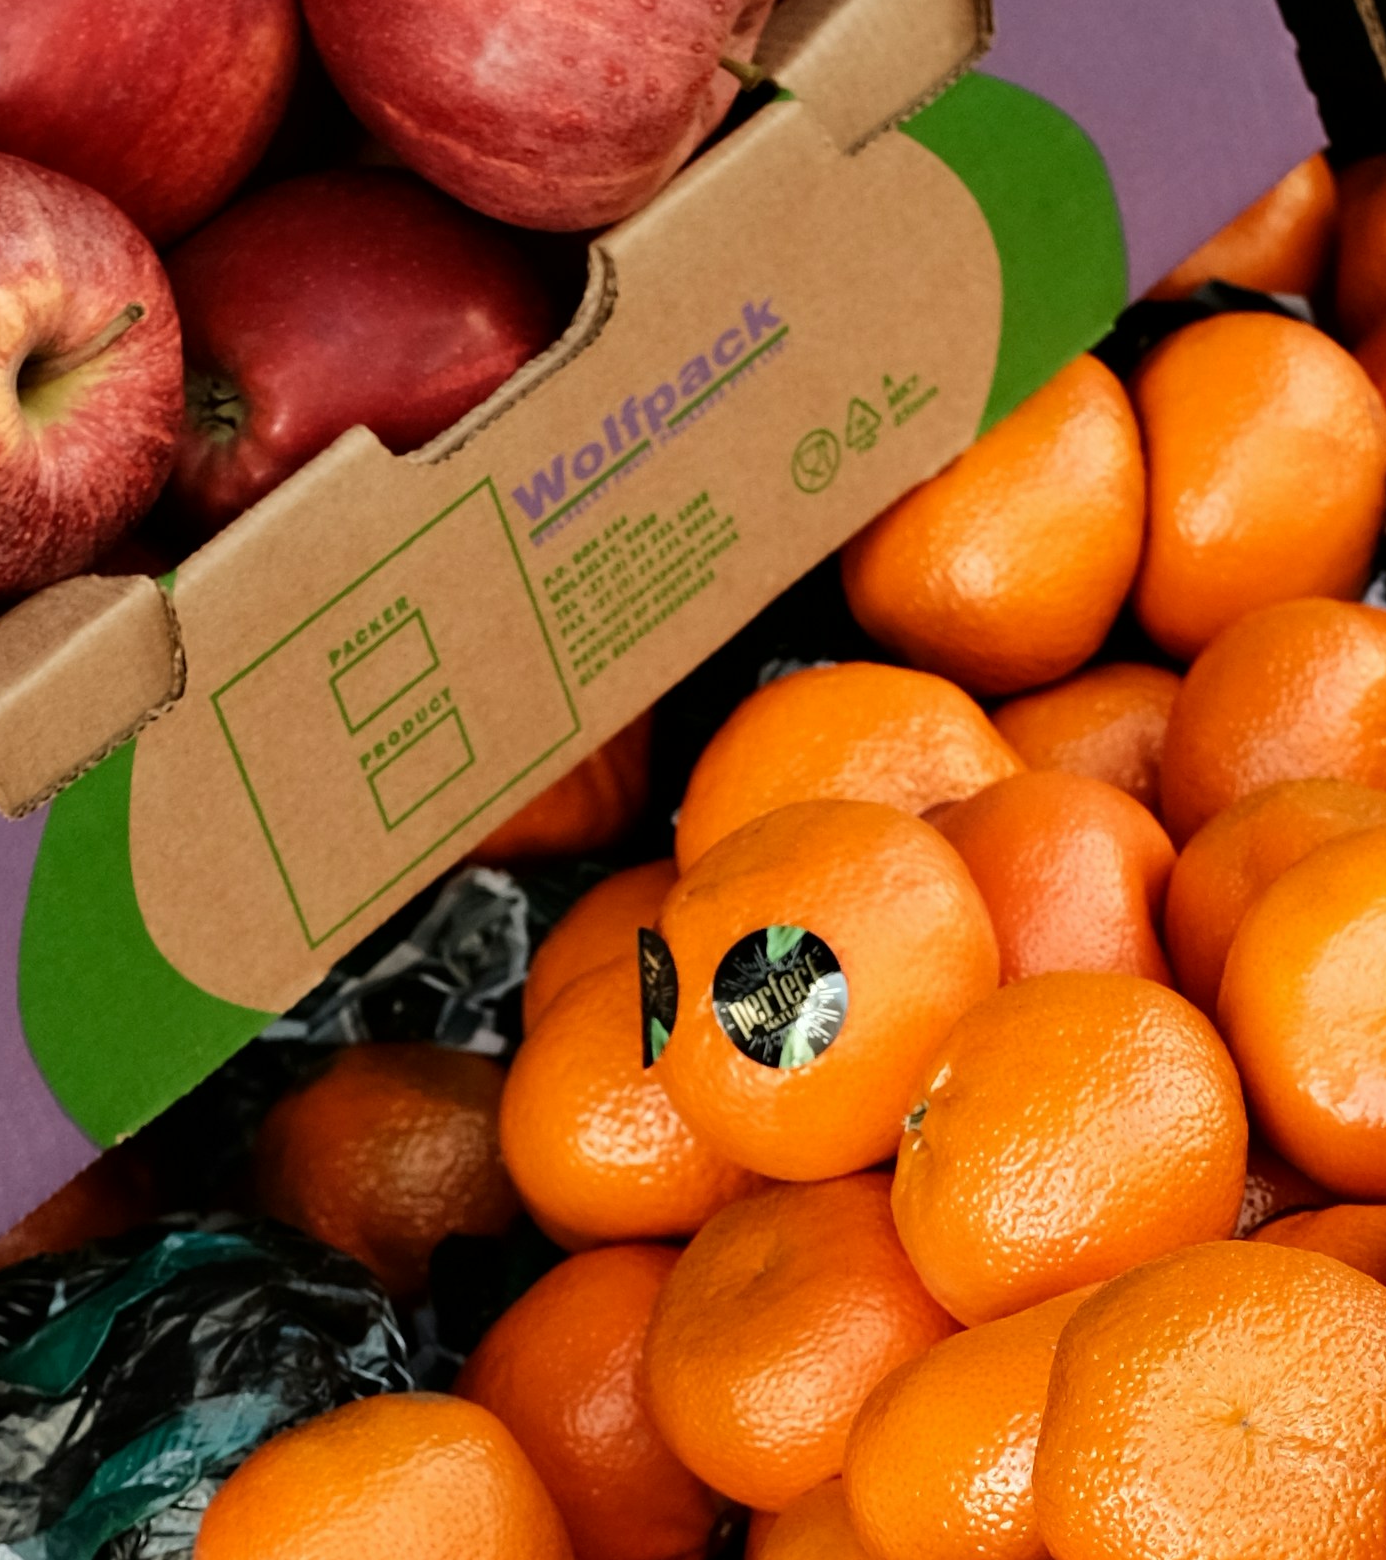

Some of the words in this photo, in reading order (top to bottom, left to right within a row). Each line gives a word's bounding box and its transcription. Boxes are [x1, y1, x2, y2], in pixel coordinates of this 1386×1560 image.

[511, 295, 787, 522] Wolfpack
[327, 594, 412, 668] PACKER
[359, 687, 454, 772] PRODUCT
[727, 952, 827, 1042] perfect
